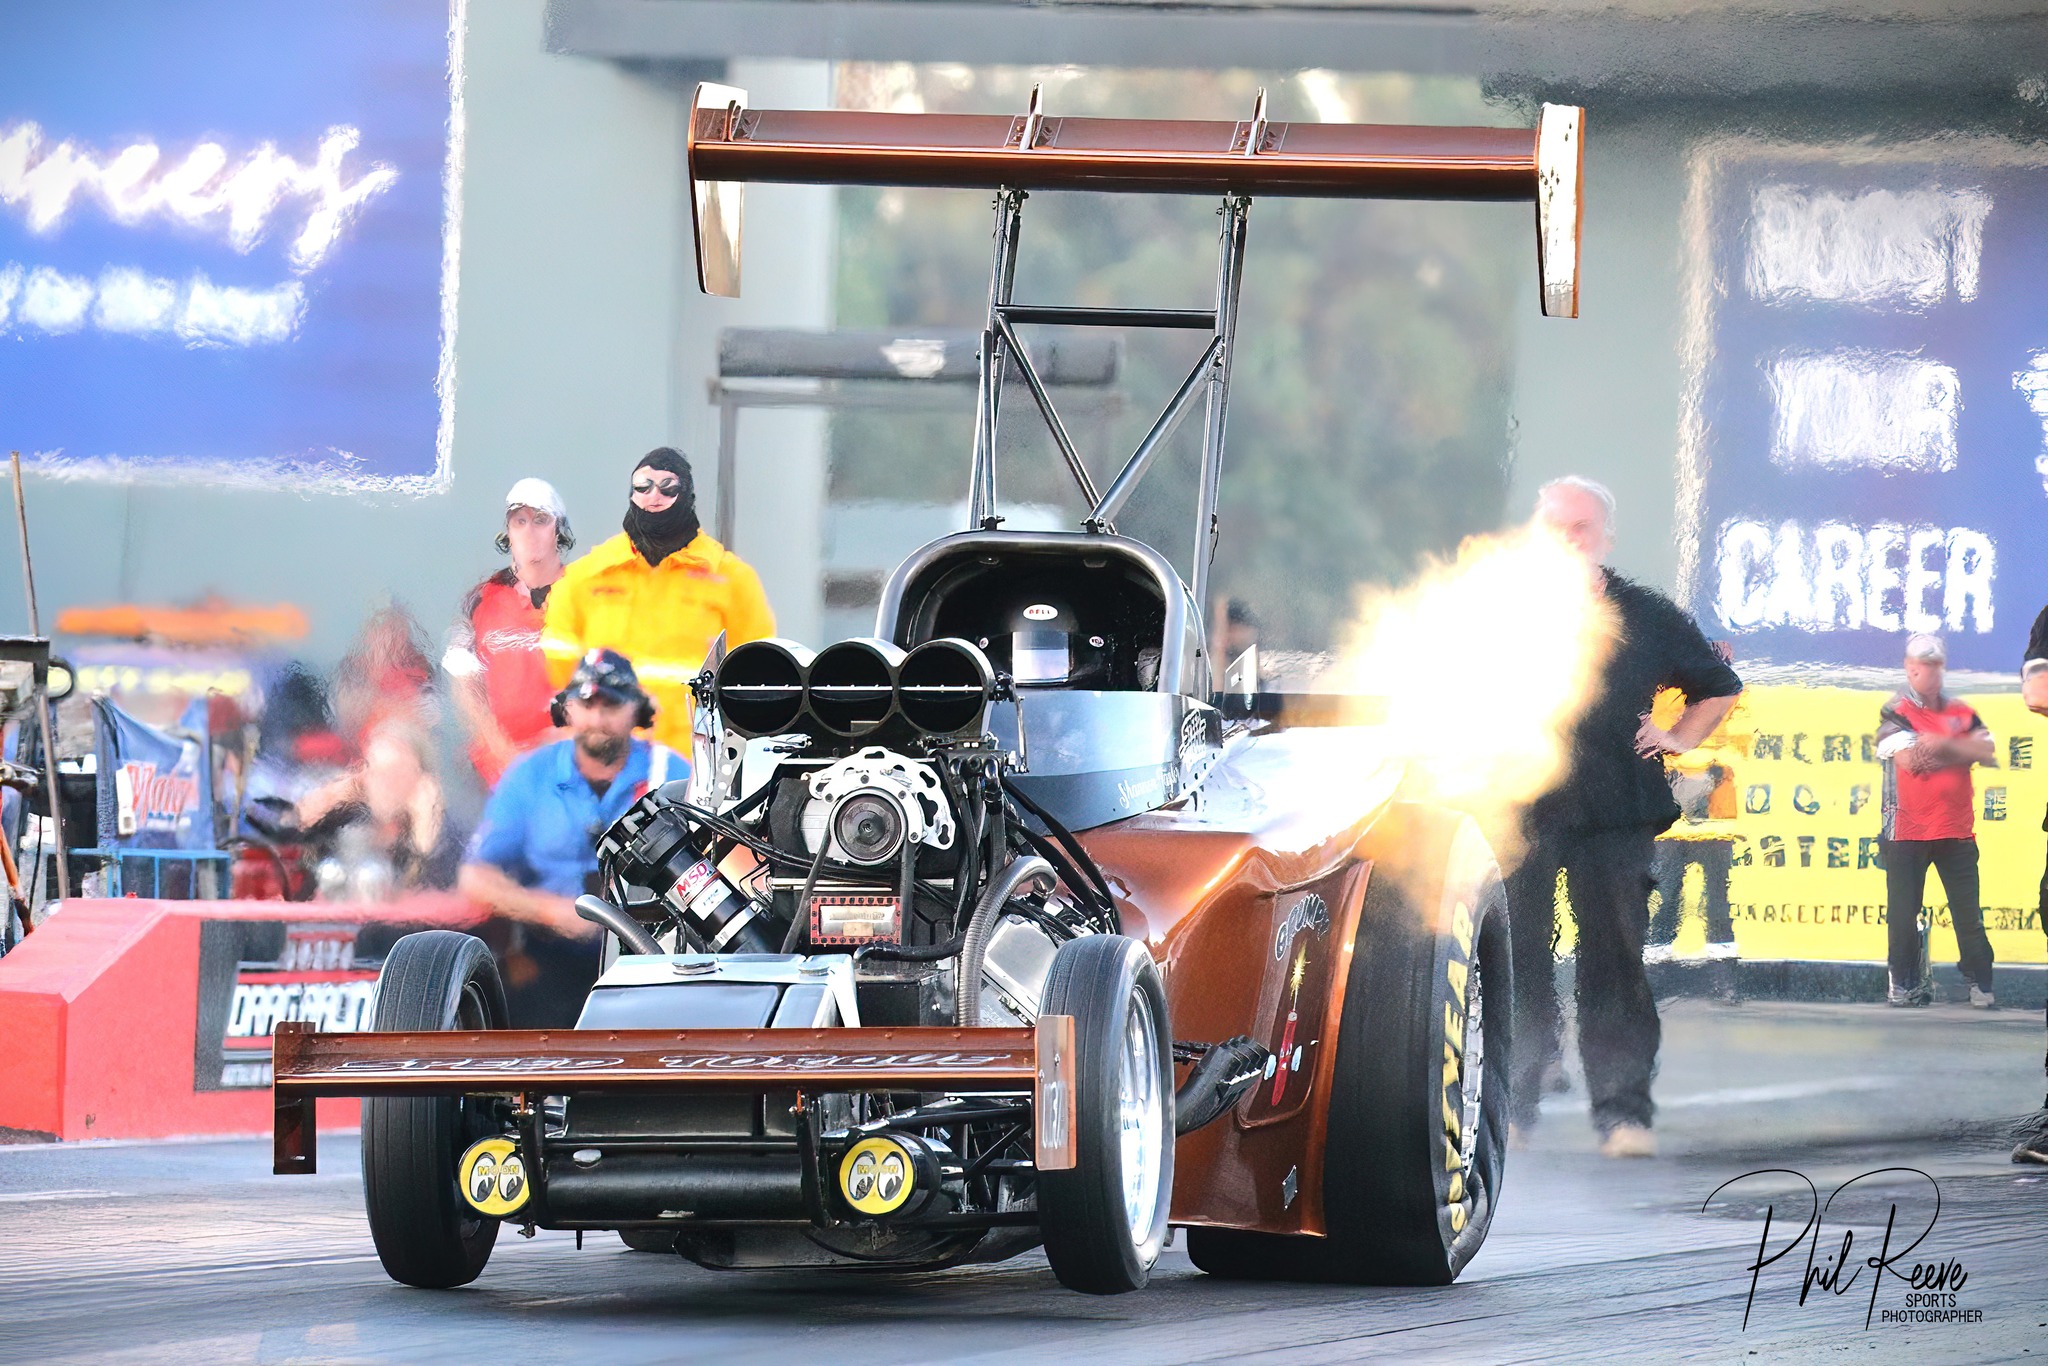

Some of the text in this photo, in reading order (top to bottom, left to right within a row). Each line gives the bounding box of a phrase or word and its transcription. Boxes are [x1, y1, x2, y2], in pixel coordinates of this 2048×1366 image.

[1714, 518, 1997, 634] CAREER
[676, 862, 708, 898] MSD
[332, 1056, 625, 1071] SPEED
[477, 1165, 519, 1176] MOON
